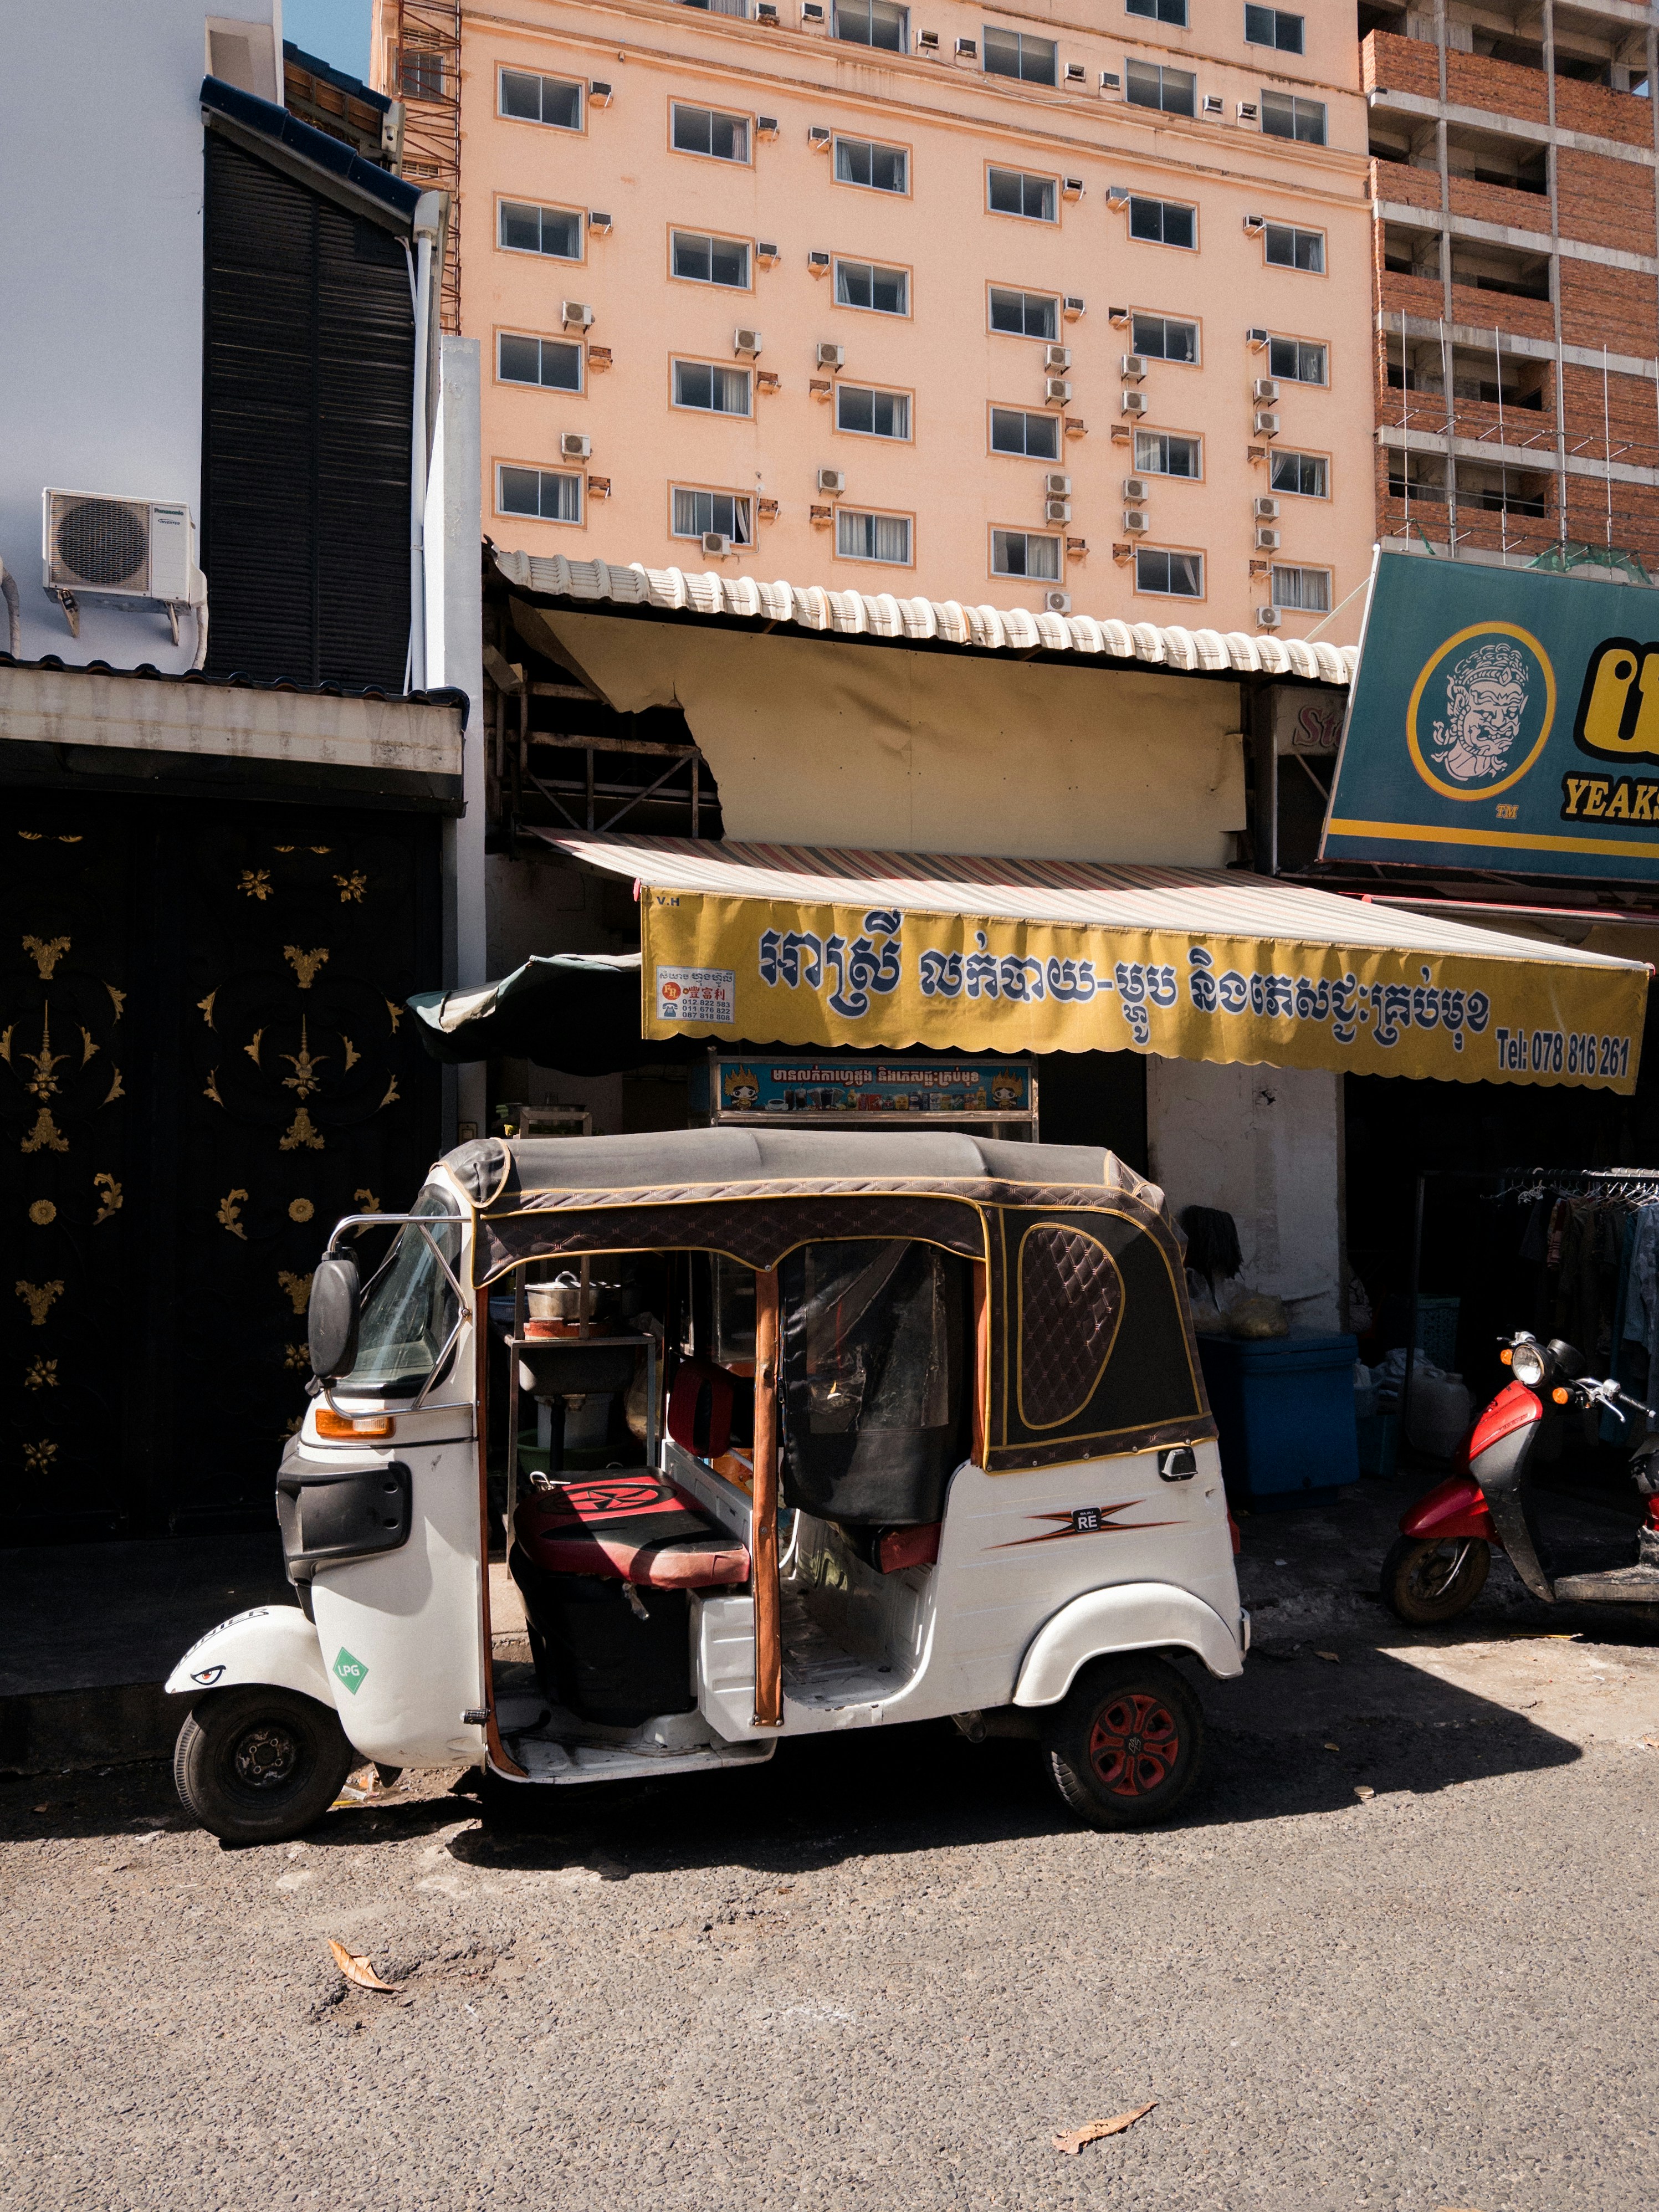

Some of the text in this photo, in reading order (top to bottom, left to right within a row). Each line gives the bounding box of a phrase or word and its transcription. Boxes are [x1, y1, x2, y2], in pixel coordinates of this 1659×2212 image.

[153, 508, 184, 516] Panasonic
[1565, 778, 1658, 820] YEAK
[1496, 803, 1519, 819] TM
[656, 896, 680, 907] V.H
[1496, 1027, 1630, 1078] Tel: 078 816 261
[1078, 1514, 1098, 1529] RE
[337, 1665, 360, 1677] LPG
